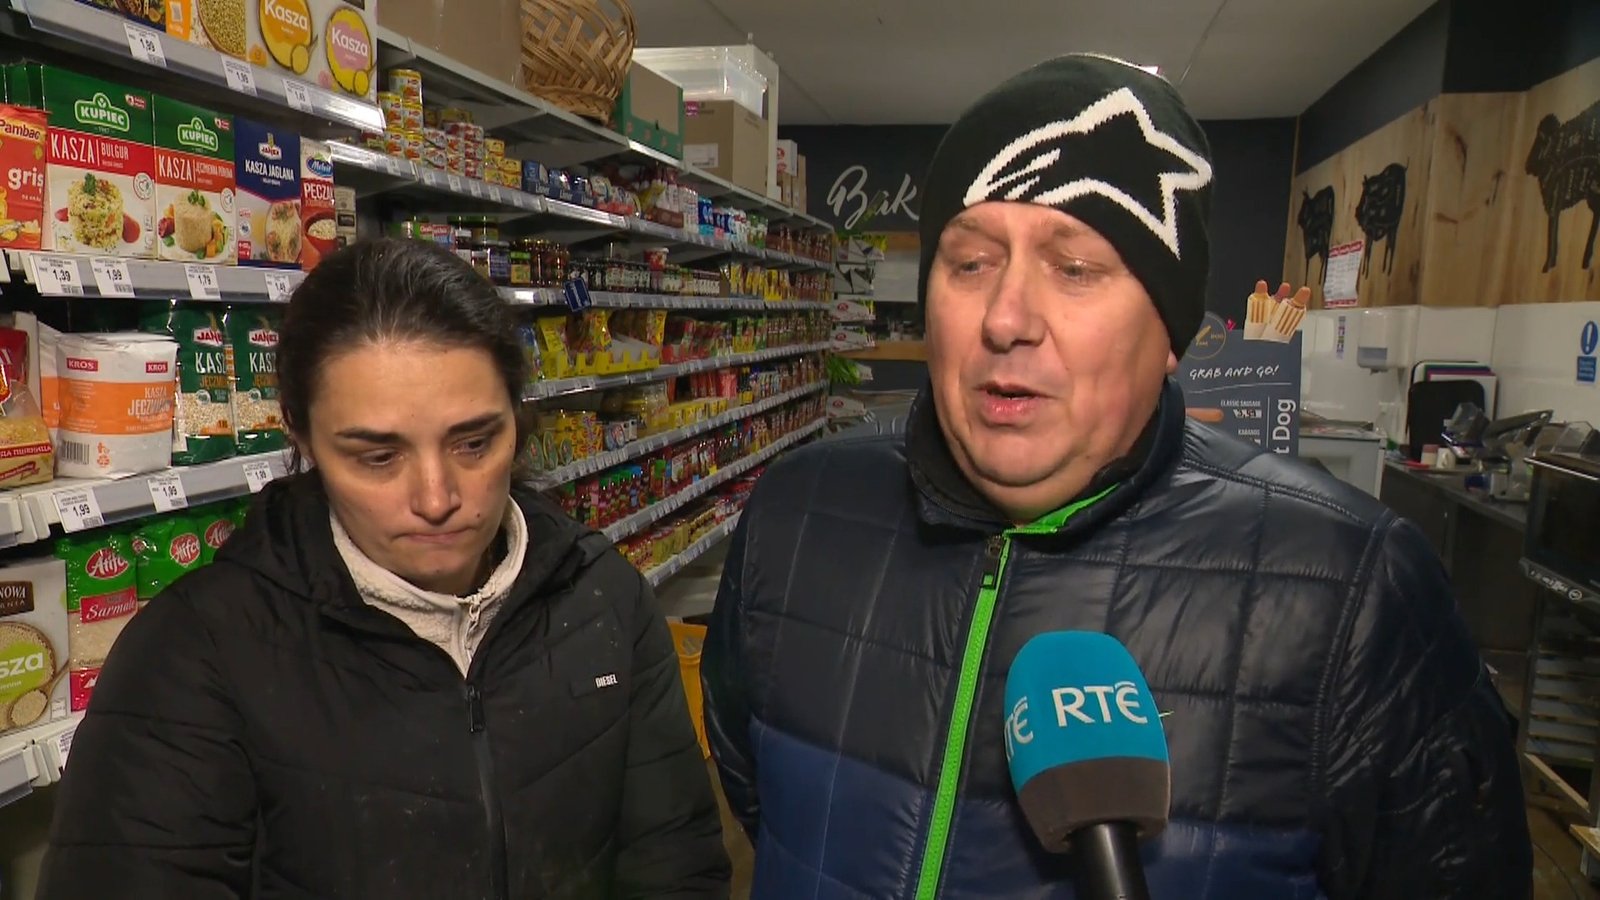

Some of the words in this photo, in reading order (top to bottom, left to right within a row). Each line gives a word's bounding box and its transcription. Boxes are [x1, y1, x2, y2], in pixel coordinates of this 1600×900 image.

[264, 0, 308, 31] Kasza
[331, 27, 369, 57] Kasza
[80, 106, 125, 125] KUPIEC
[182, 129, 215, 146] KUPIEC
[51, 132, 95, 164] KASZA
[101, 142, 129, 160] BULGUR
[158, 154, 192, 182] KASZA
[245, 160, 267, 176] KASZA
[268, 163, 295, 182] JAGLANA
[53, 269, 71, 282] 1,39
[107, 269, 122, 281] 1,99
[198, 274, 211, 287] 1,79
[68, 359, 94, 370] KROS
[147, 363, 167, 373] KROS
[195, 352, 227, 374] KASZ
[249, 352, 277, 373] KASZ
[1190, 367, 1221, 380] GRAB
[1225, 366, 1252, 378] AND
[1256, 364, 1280, 378] GO!
[145, 387, 167, 399] KASZA
[1272, 399, 1297, 440] Dog
[163, 486, 178, 498] 1,99
[73, 503, 91, 517] 1,99
[595, 674, 618, 688] DIESEL
[1052, 681, 1148, 727] RTÉ
[1004, 696, 1034, 761] TÉ
